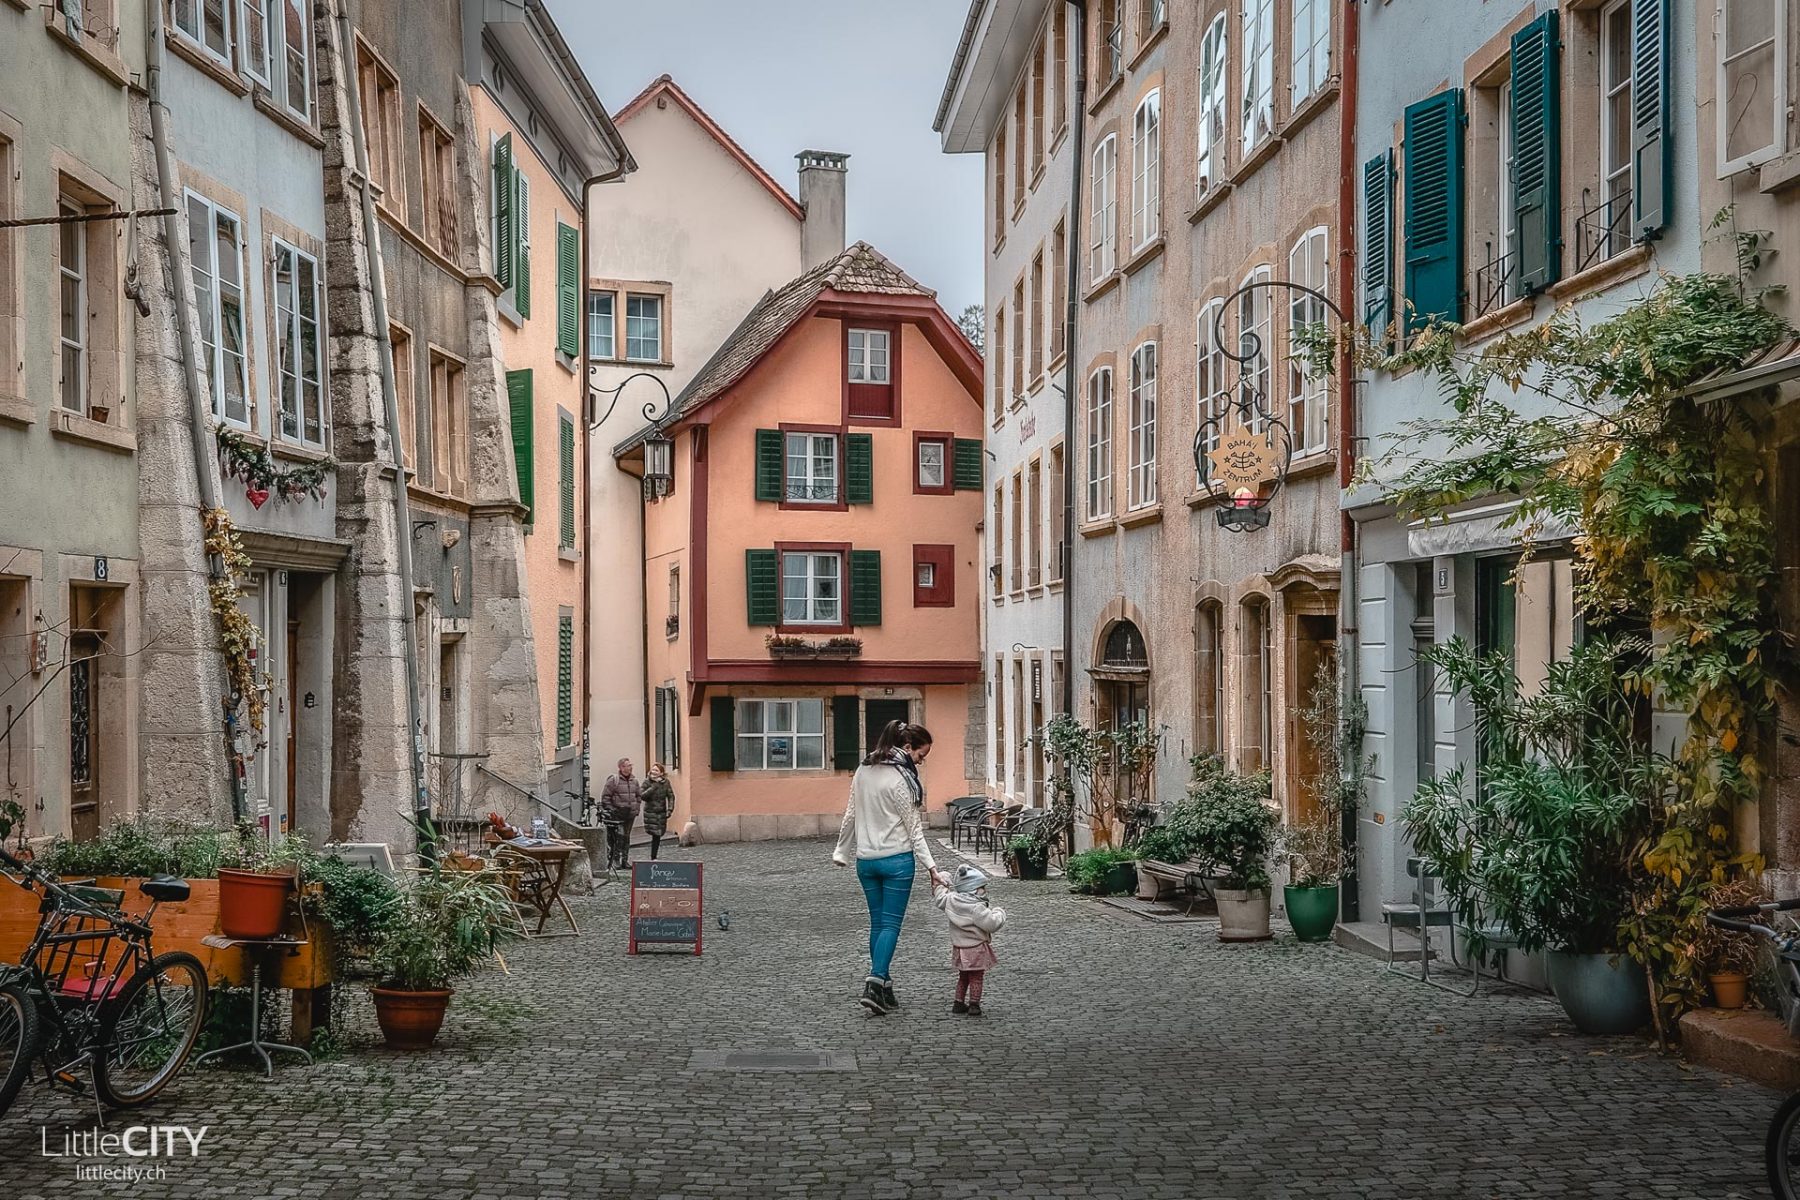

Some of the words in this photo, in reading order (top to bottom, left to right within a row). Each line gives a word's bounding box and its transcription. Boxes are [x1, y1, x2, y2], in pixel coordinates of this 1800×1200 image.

[1223, 468, 1263, 483] ZENTRUM
[98, 560, 106, 578] 8
[281, 572, 286, 584] 6
